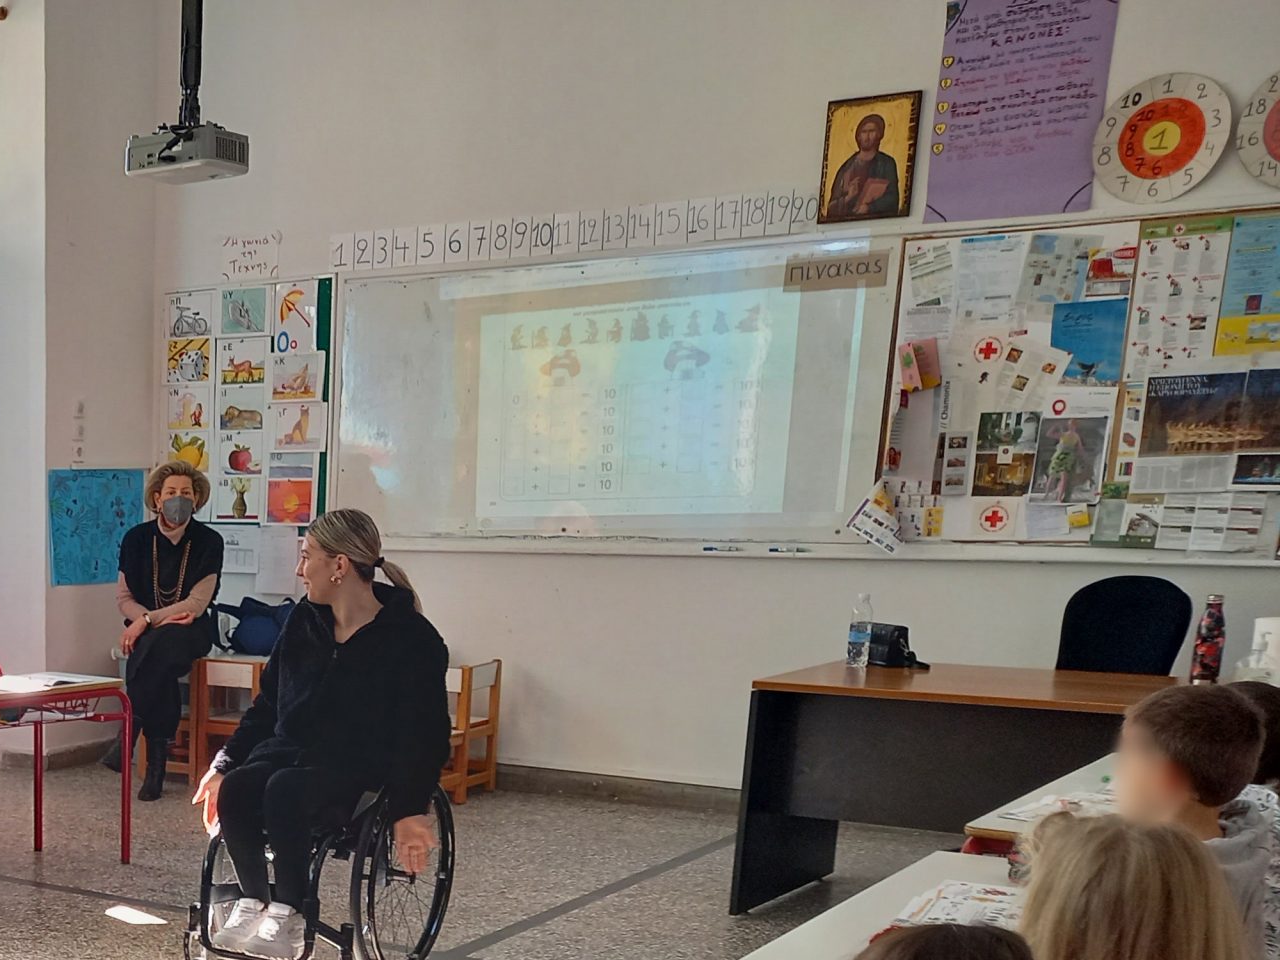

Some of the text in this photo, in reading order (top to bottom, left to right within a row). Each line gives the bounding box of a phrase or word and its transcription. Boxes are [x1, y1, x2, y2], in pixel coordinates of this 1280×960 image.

[1162, 79, 1174, 94] 1
[1196, 83, 1208, 99] 2
[1120, 92, 1142, 109] 10
[1243, 98, 1267, 117] 18
[1136, 109, 1156, 122] 10
[1211, 109, 1222, 127] 3
[1105, 117, 1117, 138] 9
[1129, 124, 1138, 140] 9
[1149, 128, 1169, 150] 1
[1236, 131, 1259, 150] 16
[1097, 146, 1111, 166] 8
[1125, 142, 1135, 158] 8
[1205, 142, 1215, 156] 4
[1151, 160, 1162, 175] 6
[1256, 161, 1278, 177] 14
[1116, 175, 1131, 192] 7
[1183, 168, 1194, 186] 5
[1147, 183, 1158, 197] 6
[333, 195, 818, 267] 1 2 3 4 5 6 7 8 9 10 11 12 13 14 15 16 17 18 19 20
[604, 388, 616, 400] 10
[603, 406, 615, 417] 10
[602, 425, 614, 436] 10
[601, 443, 613, 454] 10
[600, 461, 613, 472] 10
[599, 479, 612, 490] 10
